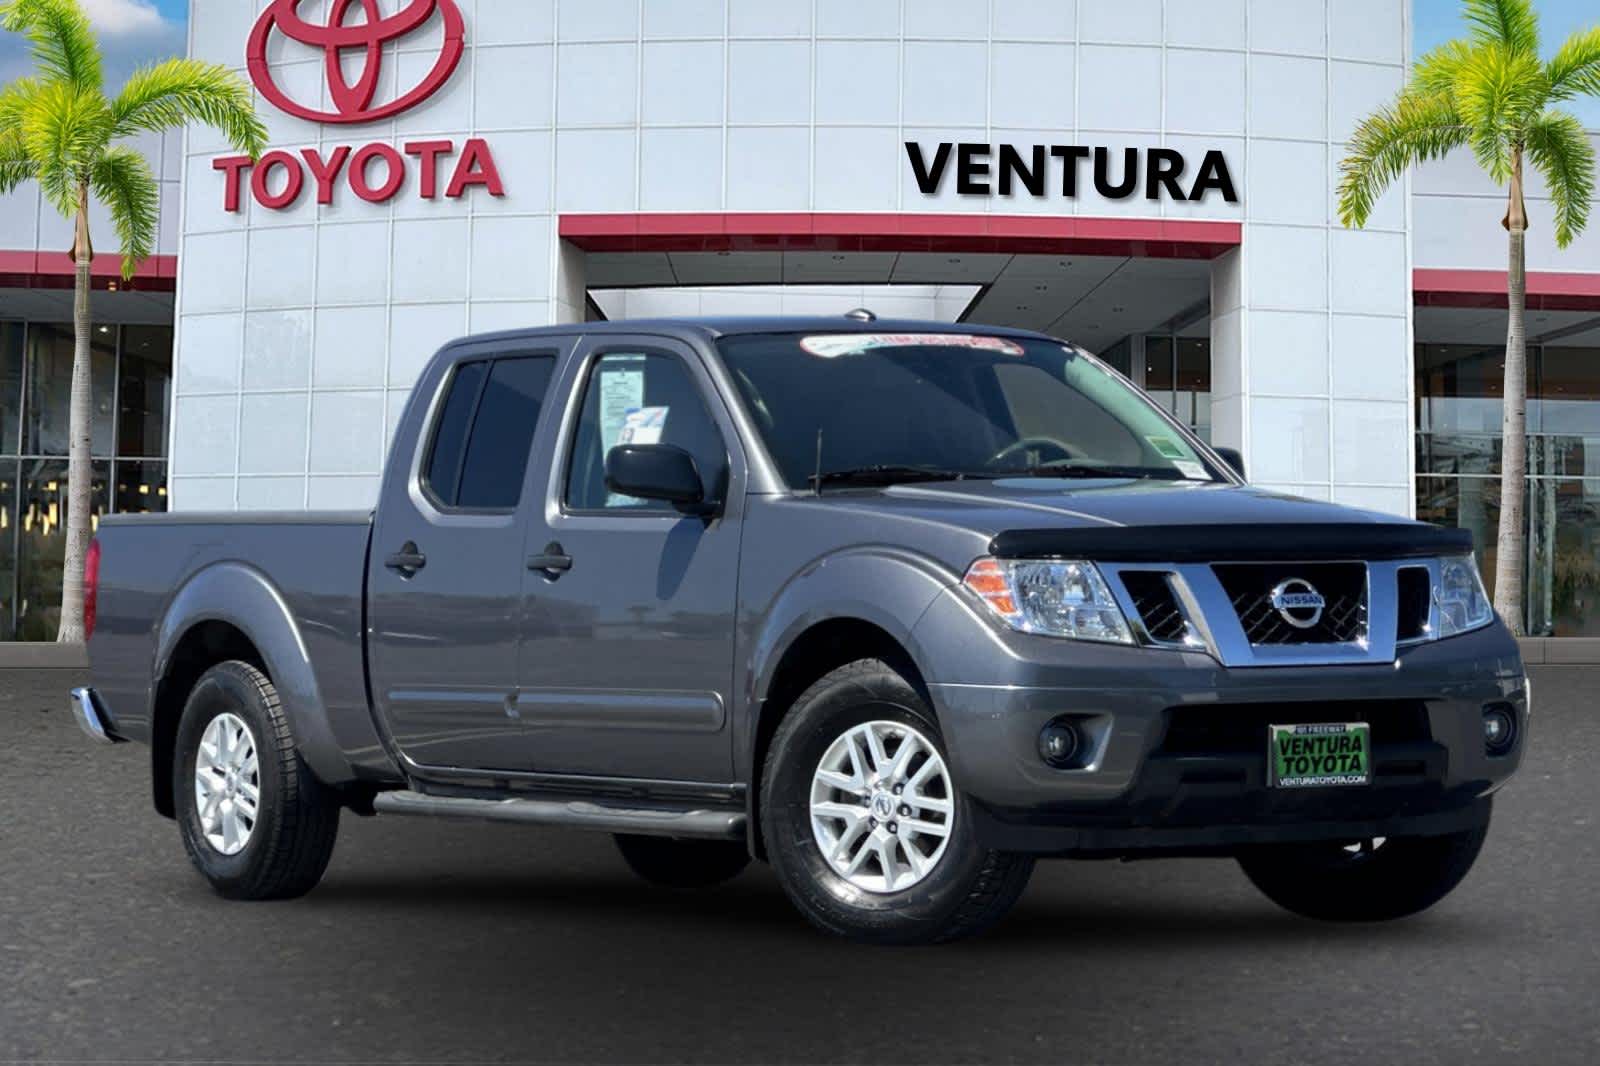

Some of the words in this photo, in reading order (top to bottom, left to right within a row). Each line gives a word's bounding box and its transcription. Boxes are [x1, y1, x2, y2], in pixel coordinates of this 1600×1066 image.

[213, 138, 504, 211] TOYOTA
[905, 142, 1238, 202] VENTURA
[1280, 595, 1323, 605] NISSAN
[1280, 735, 1362, 756] VENTURA
[1282, 754, 1362, 774] TOYOTA
